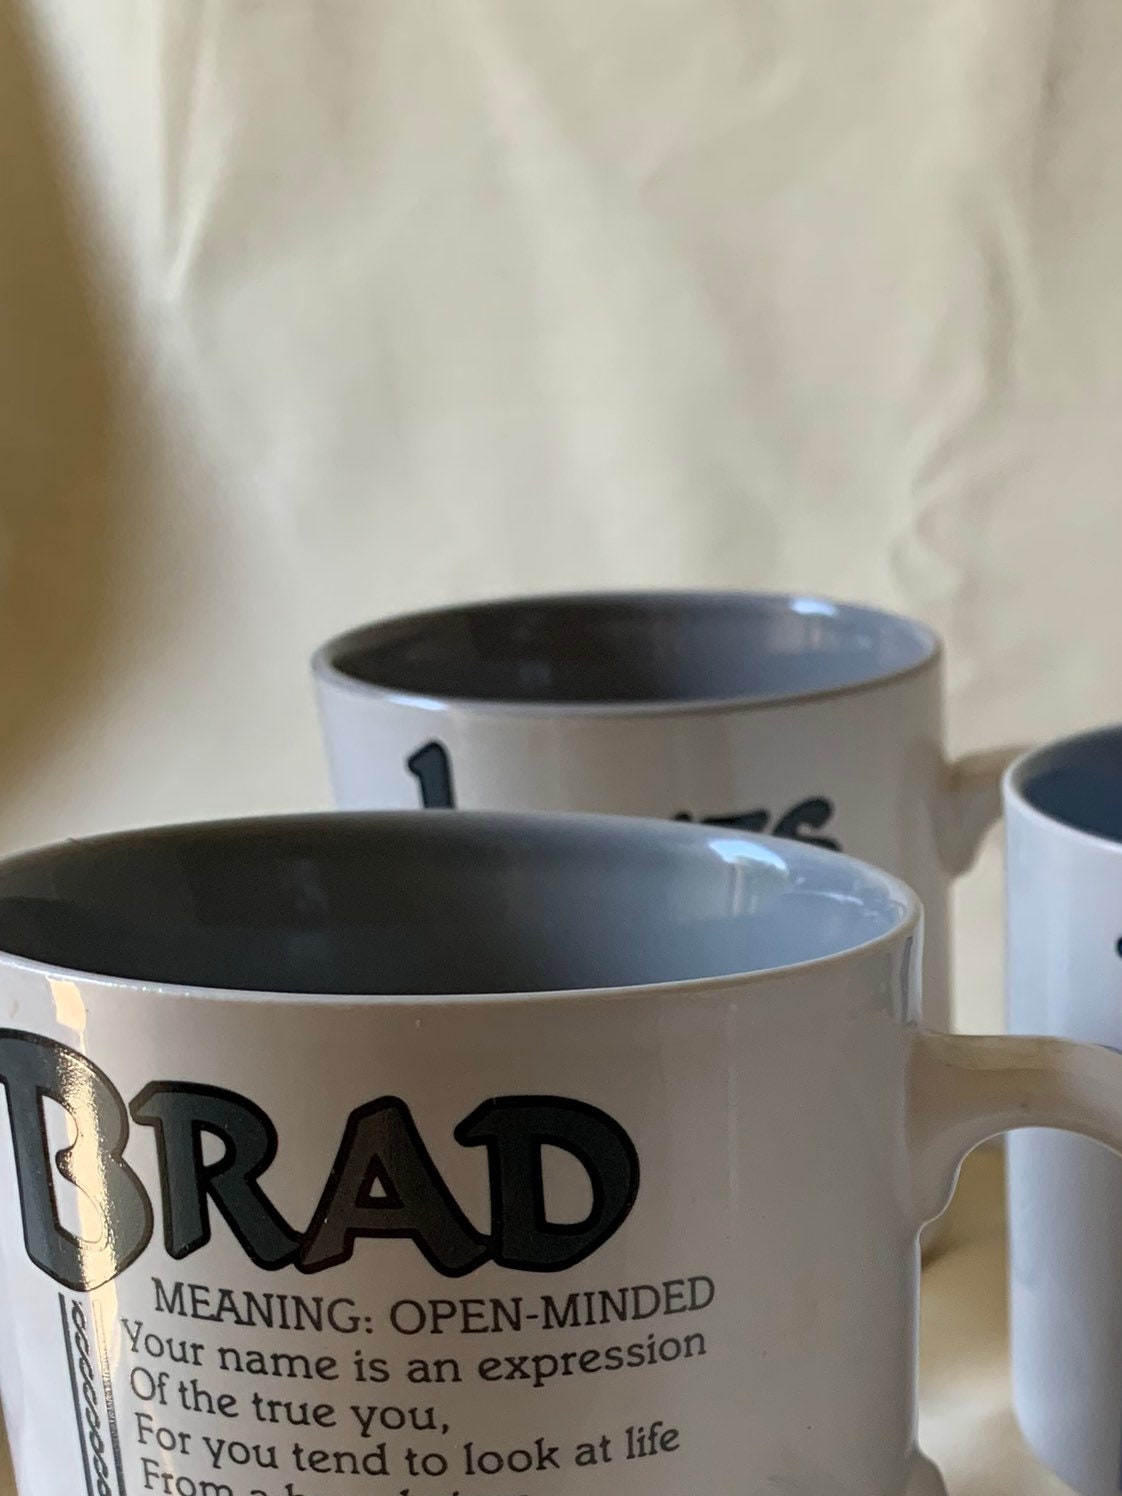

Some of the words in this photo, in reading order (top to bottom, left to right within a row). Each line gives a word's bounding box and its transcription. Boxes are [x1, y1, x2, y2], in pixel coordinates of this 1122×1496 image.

[0, 1029, 640, 1291] BRAD
[151, 1277, 373, 1334] MEANING:
[390, 1276, 715, 1335] OPEN-MINDED
[121, 1318, 204, 1366] Your
[218, 1347, 339, 1380] name
[354, 1350, 390, 1383] is
[407, 1359, 462, 1383] an
[478, 1333, 706, 1387] expression
[130, 1367, 169, 1405] Of
[178, 1379, 239, 1418] the
[252, 1392, 337, 1427] true
[350, 1400, 449, 1438] you,
[134, 1412, 191, 1455] For
[202, 1437, 279, 1469] you
[292, 1442, 390, 1476] tend
[405, 1448, 448, 1476] to
[463, 1437, 560, 1475] look
[575, 1435, 612, 1466] at
[625, 1421, 680, 1459] life
